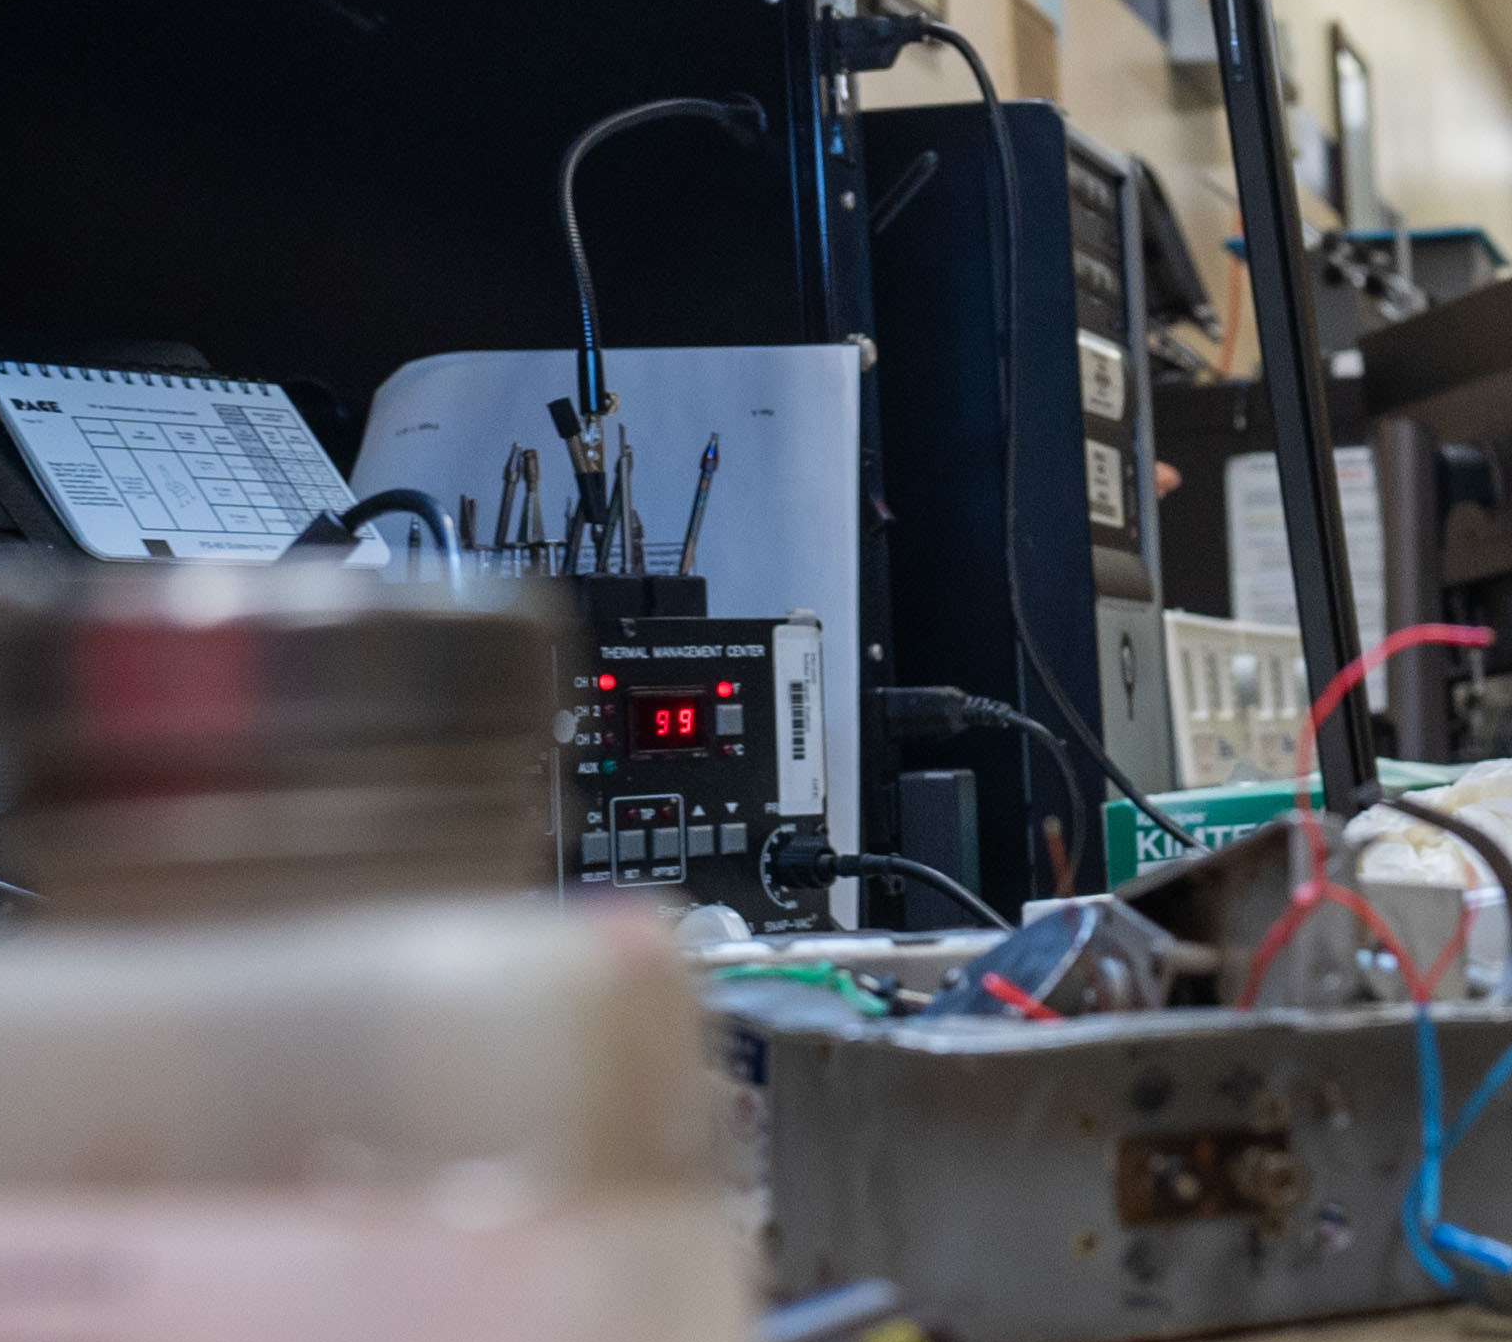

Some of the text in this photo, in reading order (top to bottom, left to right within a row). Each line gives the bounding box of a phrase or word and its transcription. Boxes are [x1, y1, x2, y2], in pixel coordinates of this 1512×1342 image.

[600, 644, 765, 659] THERMAL MANAGEMENT CENTER
